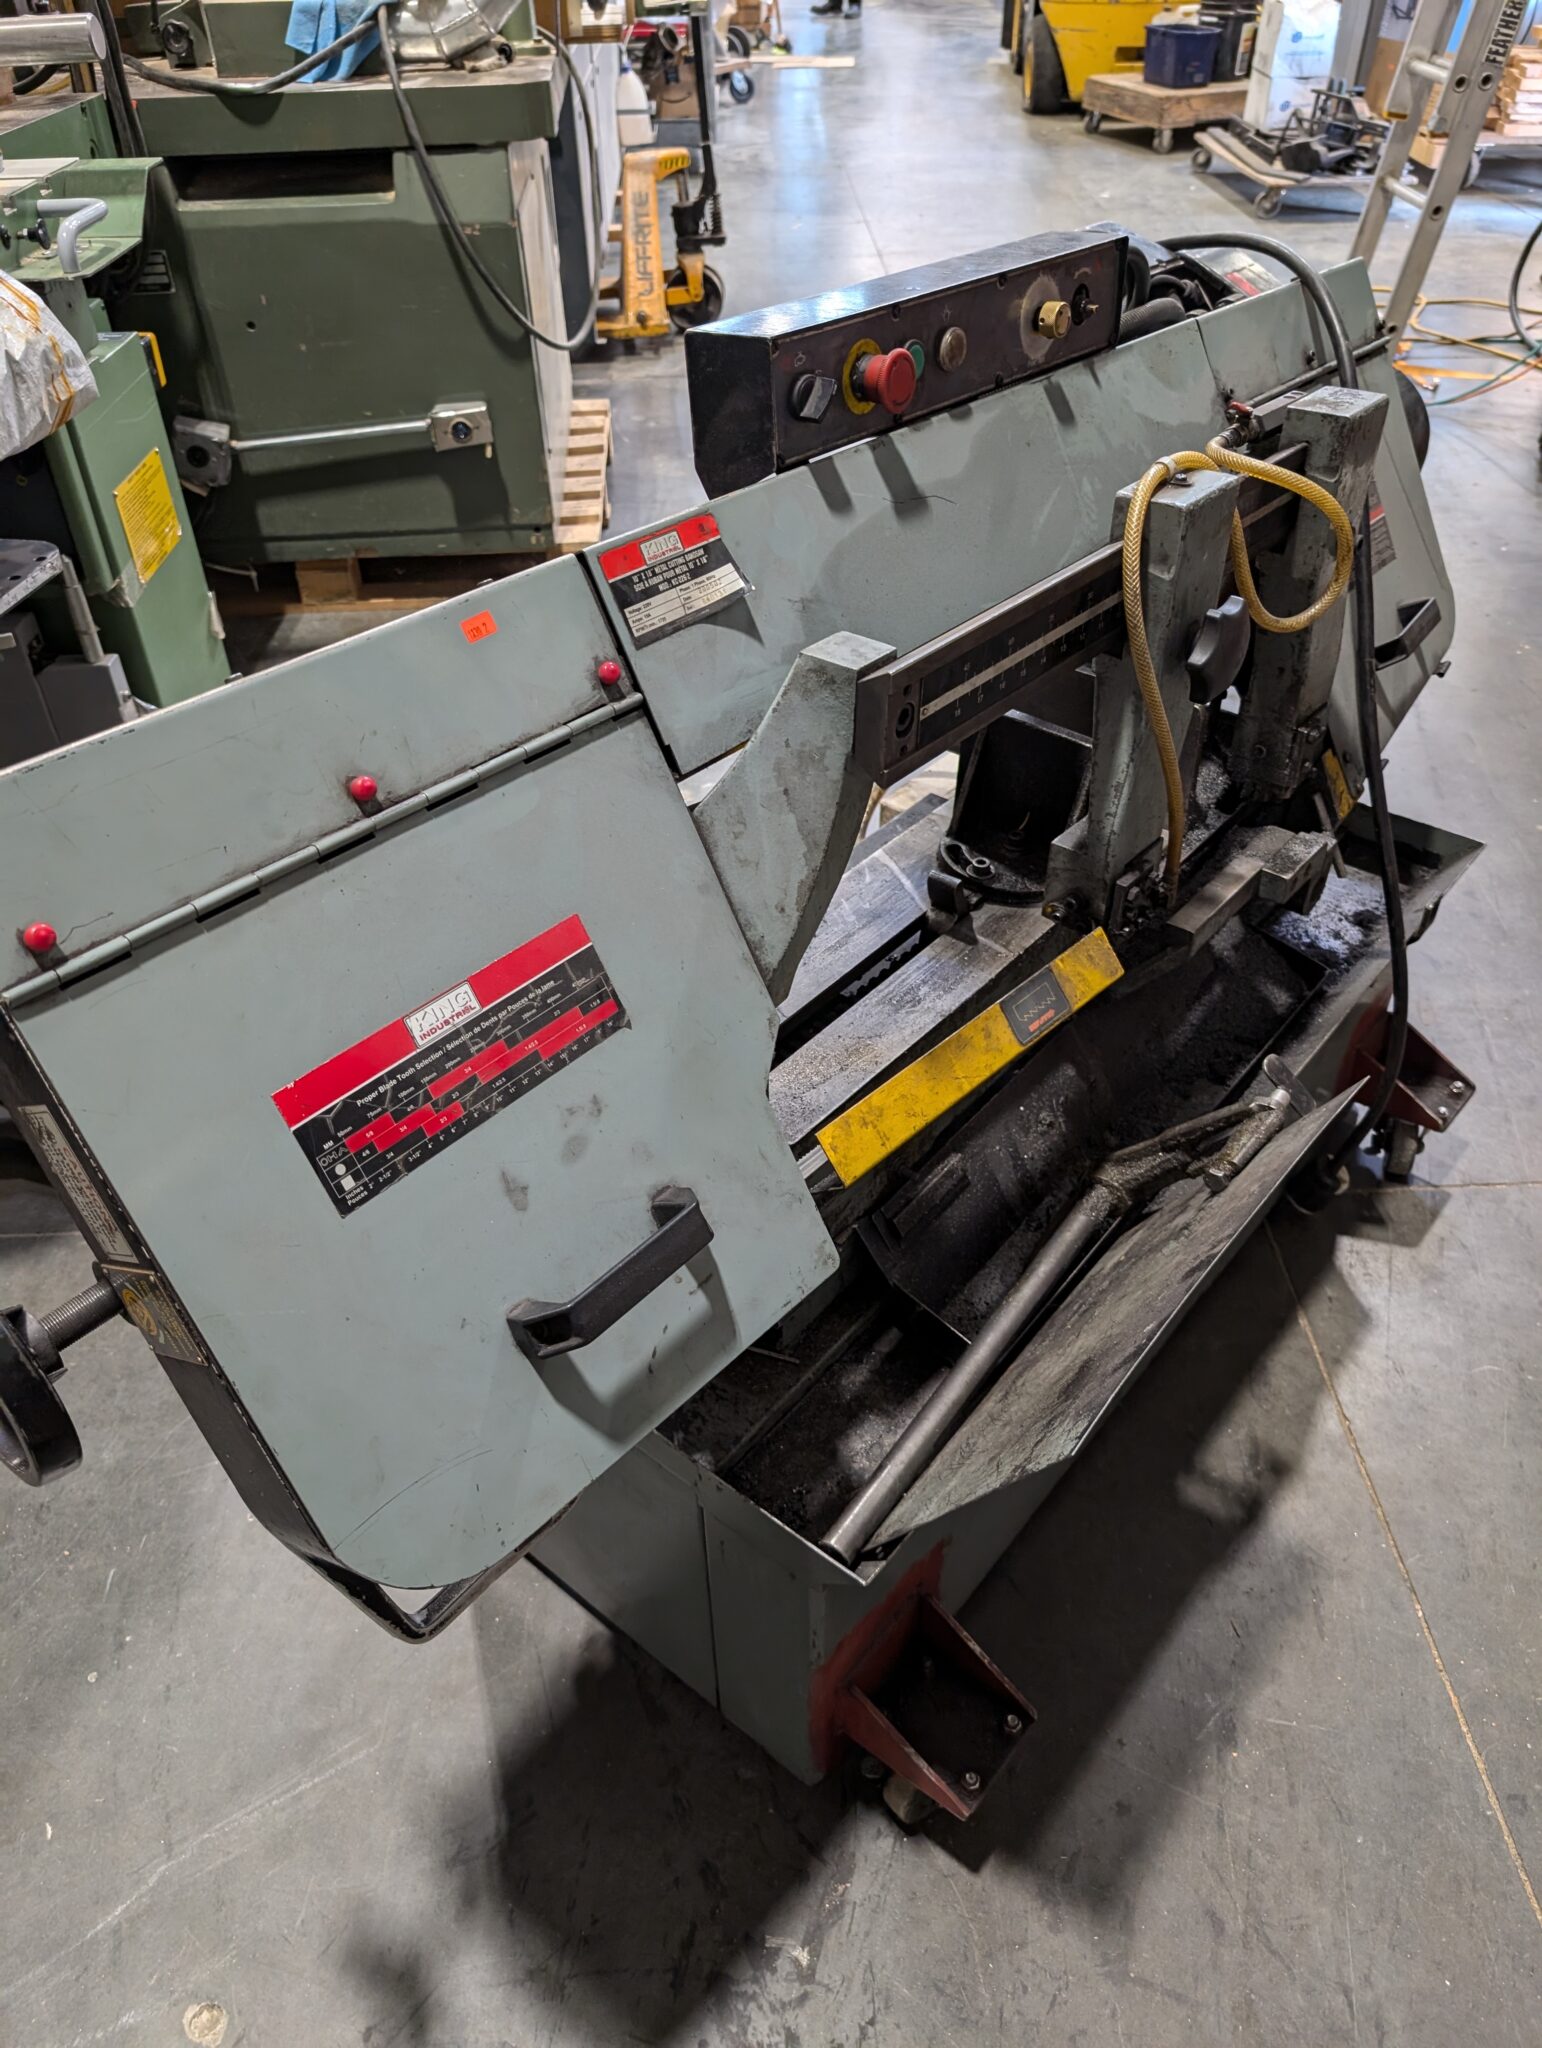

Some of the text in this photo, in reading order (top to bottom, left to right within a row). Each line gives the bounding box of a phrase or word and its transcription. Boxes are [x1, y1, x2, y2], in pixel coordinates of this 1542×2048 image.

[1485, 0, 1525, 64] FEATHER
[645, 534, 679, 553] KING
[653, 562, 668, 574] METAL
[666, 554, 685, 568] CUTTING
[683, 546, 705, 561] BANDSAW
[647, 573, 663, 586] RUBAN
[662, 568, 675, 579] POUR
[413, 989, 472, 1033] KING
[355, 1088, 379, 1107] Proper
[378, 1077, 397, 1092] Blade
[396, 1065, 416, 1081] Tooth
[414, 1048, 443, 1070] Selection
[472, 1024, 481, 1034] de
[480, 1014, 498, 1029] Dents
[497, 1009, 509, 1020] par
[507, 995, 528, 1012] Pouces
[527, 990, 536, 999] de
[540, 978, 555, 991] lame
[322, 1139, 334, 1149] MM
[344, 1183, 364, 1200] Inches
[346, 1188, 368, 1206] Pouces
